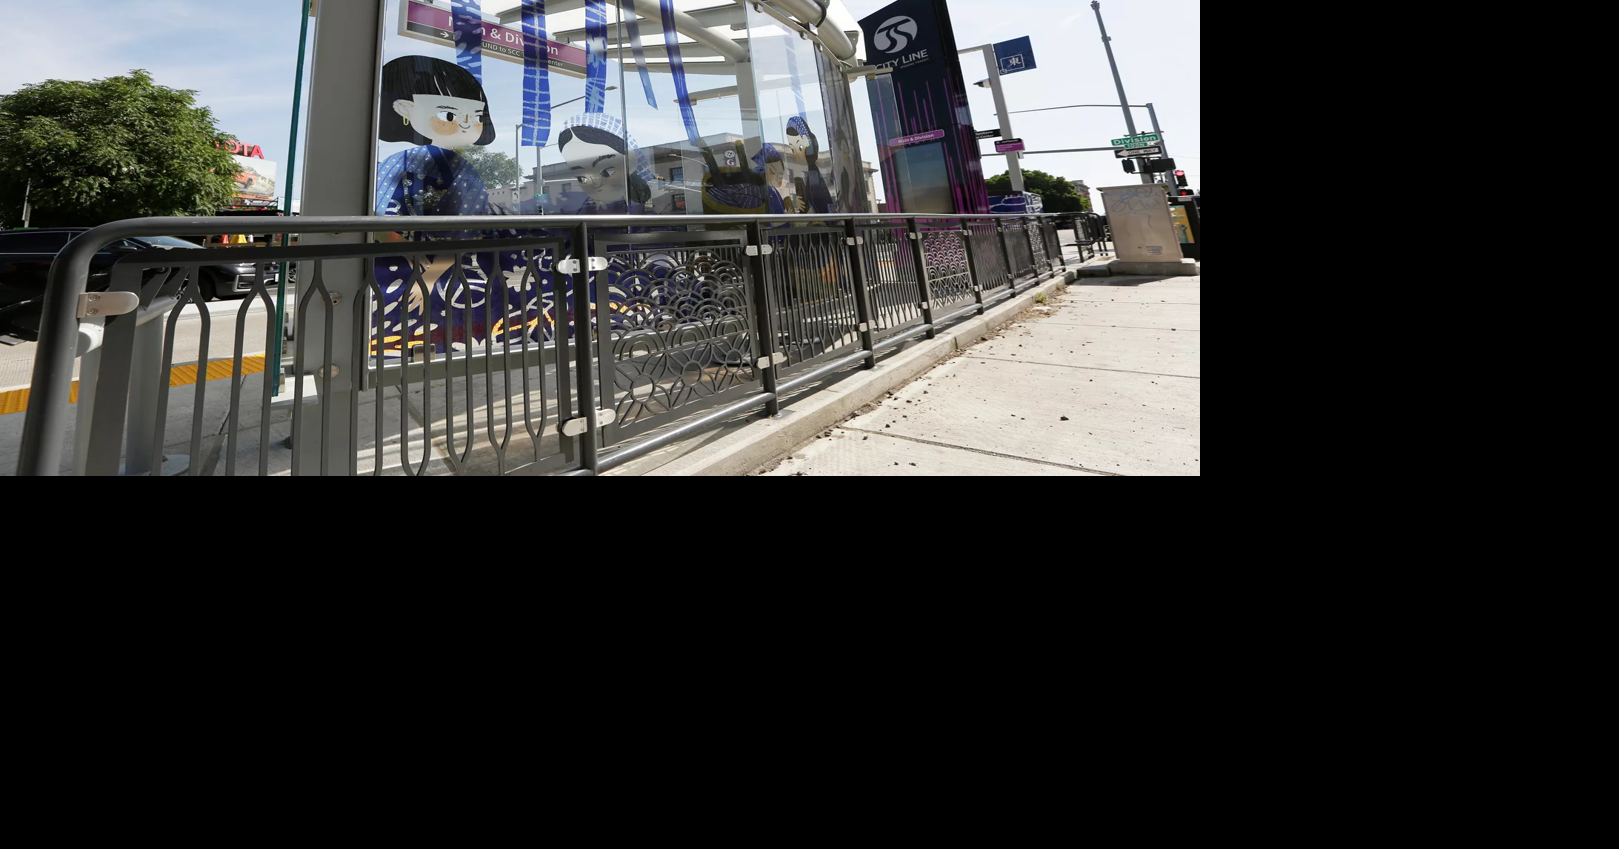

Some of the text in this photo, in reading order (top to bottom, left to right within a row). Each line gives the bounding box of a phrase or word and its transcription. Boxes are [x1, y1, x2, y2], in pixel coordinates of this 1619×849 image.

[490, 28, 501, 40] &
[507, 49, 521, 57] SCC
[902, 49, 928, 64] LINE
[914, 133, 935, 141] Division
[1113, 135, 1157, 145] Division
